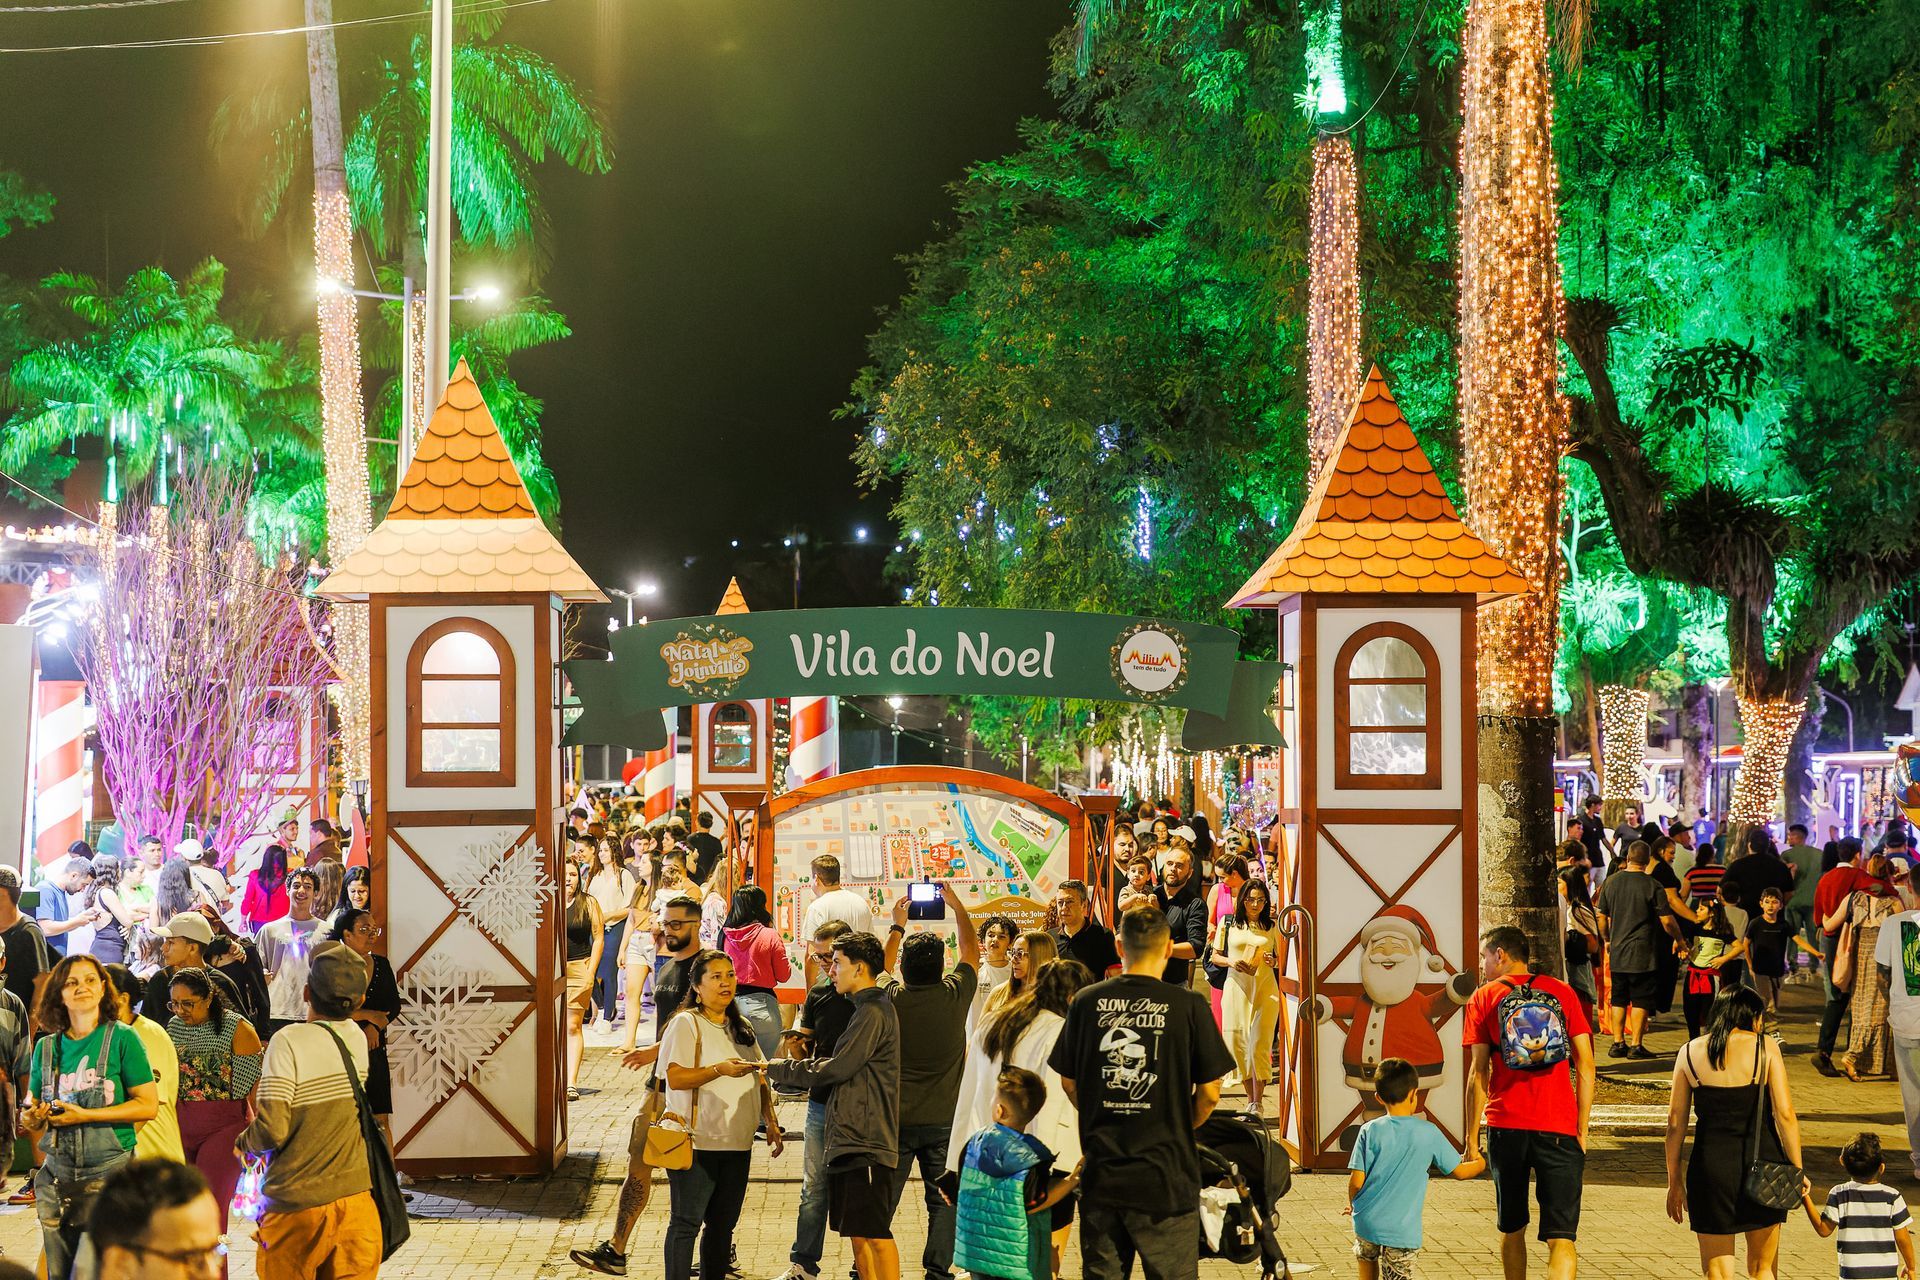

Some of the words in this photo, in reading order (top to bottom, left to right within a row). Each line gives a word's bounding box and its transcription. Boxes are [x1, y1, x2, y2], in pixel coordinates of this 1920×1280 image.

[663, 642, 719, 662] Natal
[789, 629, 879, 678] Vila
[890, 628, 943, 676] do
[956, 631, 1055, 678] Noel
[671, 659, 746, 684] Joinville
[931, 847, 939, 858] 2
[1096, 998, 1130, 1012] SLOW
[1130, 997, 1169, 1016] Days
[1098, 1011, 1136, 1030] Coffee
[1135, 1013, 1166, 1028] CLUB
